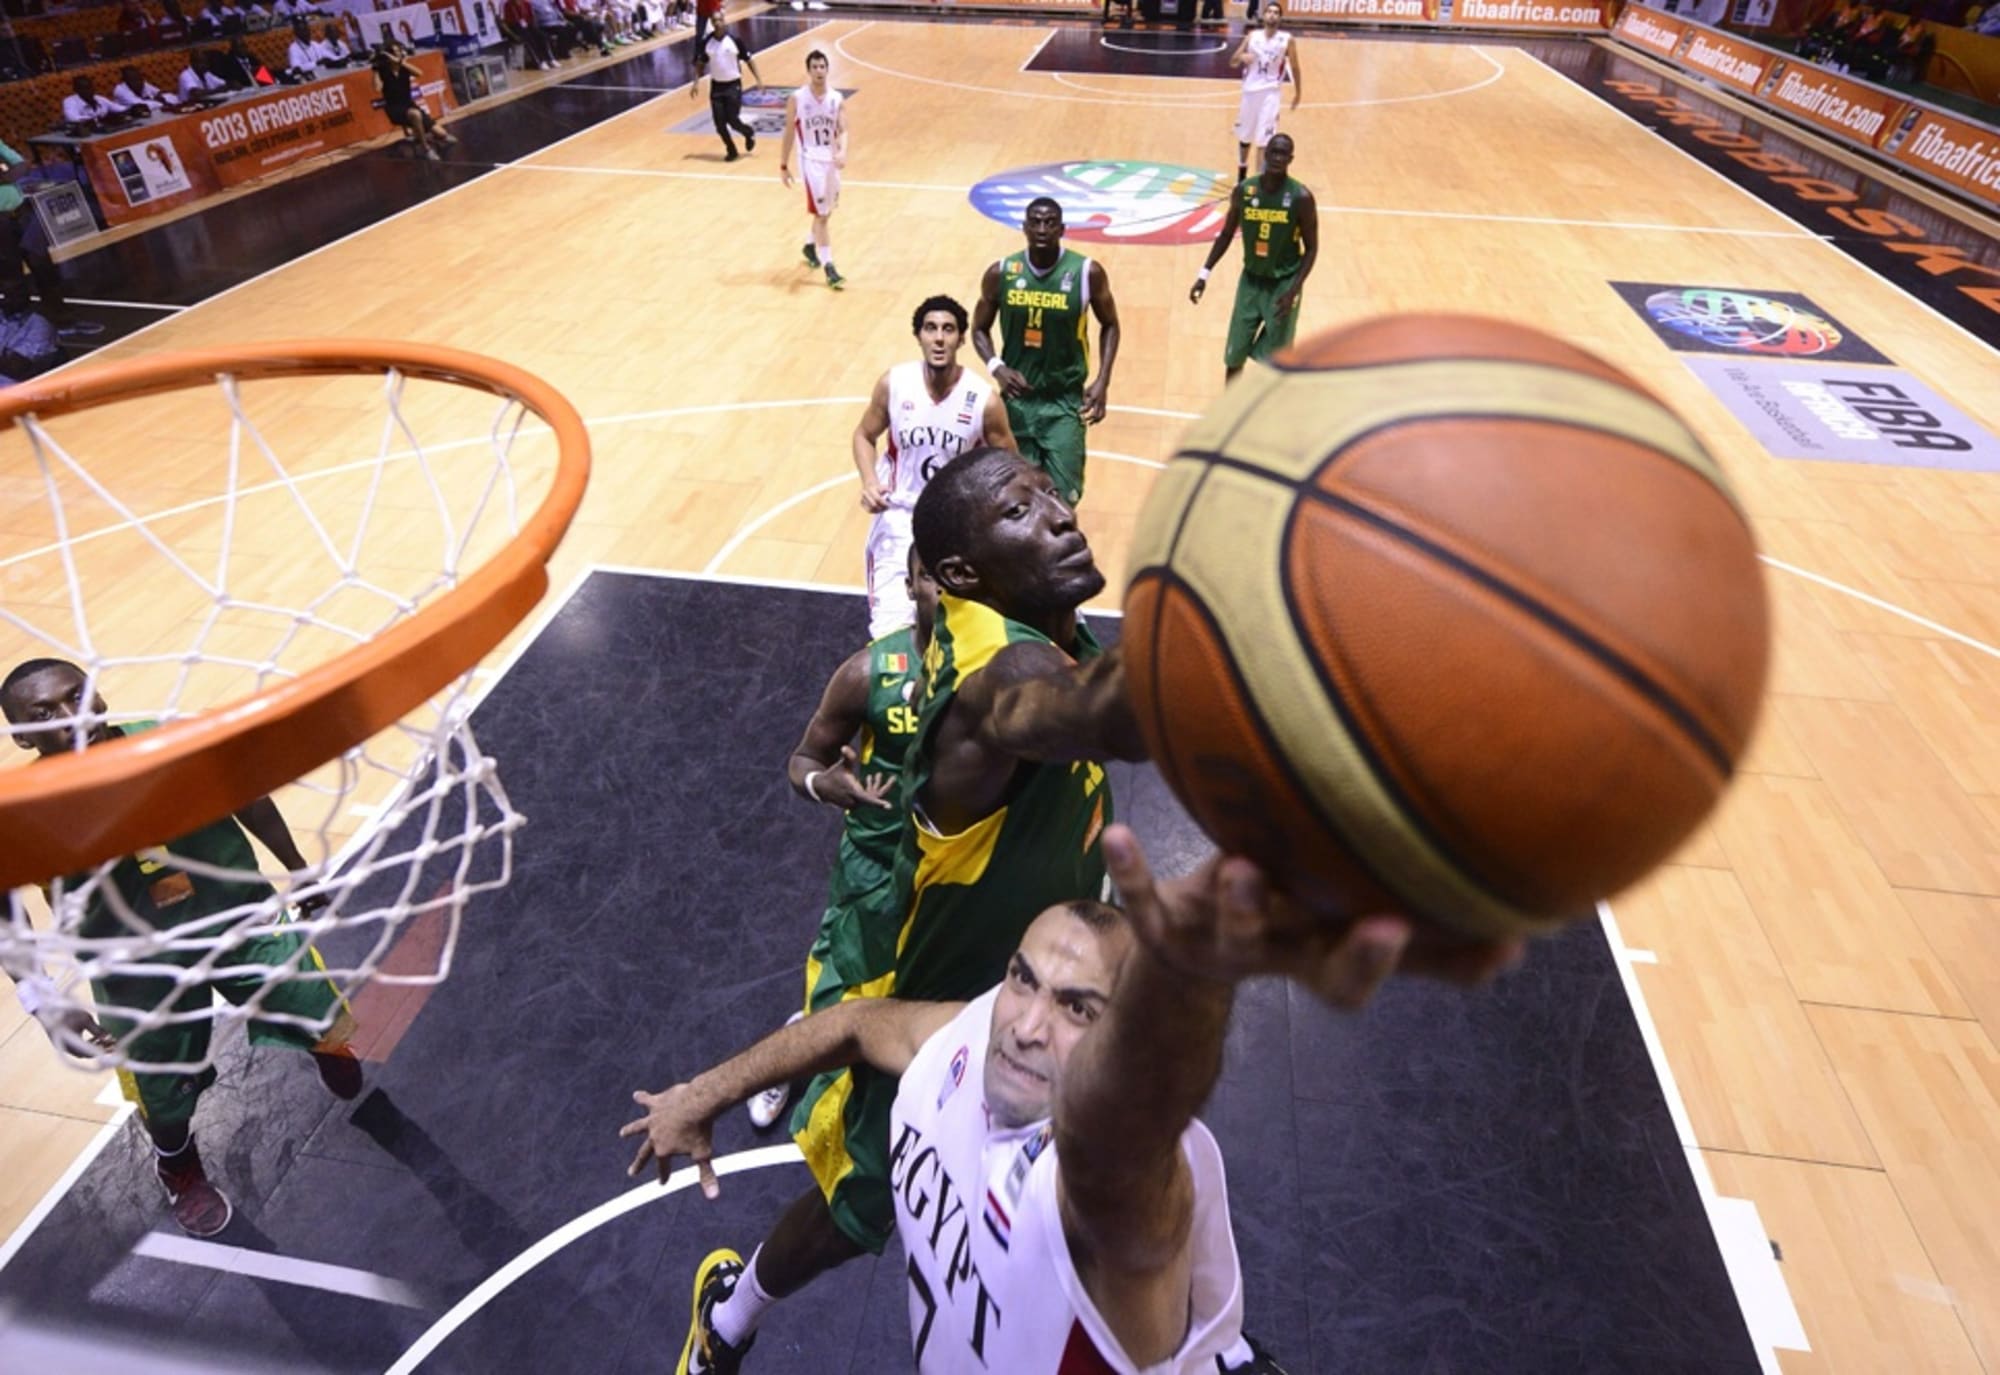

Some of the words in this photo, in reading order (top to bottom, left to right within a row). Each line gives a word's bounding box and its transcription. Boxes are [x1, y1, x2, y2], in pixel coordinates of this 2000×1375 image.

[1461, 0, 1601, 23] fibaafrica.com
[1776, 71, 1885, 137] fibaafrica.com
[201, 112, 248, 149] 2013
[247, 84, 349, 135] AFROBASKET
[814, 127, 830, 146] 12
[1244, 206, 1289, 223] SENEGAL
[1260, 223, 1271, 240] 9
[1007, 289, 1069, 310] SENEGAL
[1027, 307, 1043, 329] 14
[1821, 378, 1973, 452] FIBA
[899, 426, 968, 455] EGYPT
[891, 1122, 1002, 1371] EGYPT
